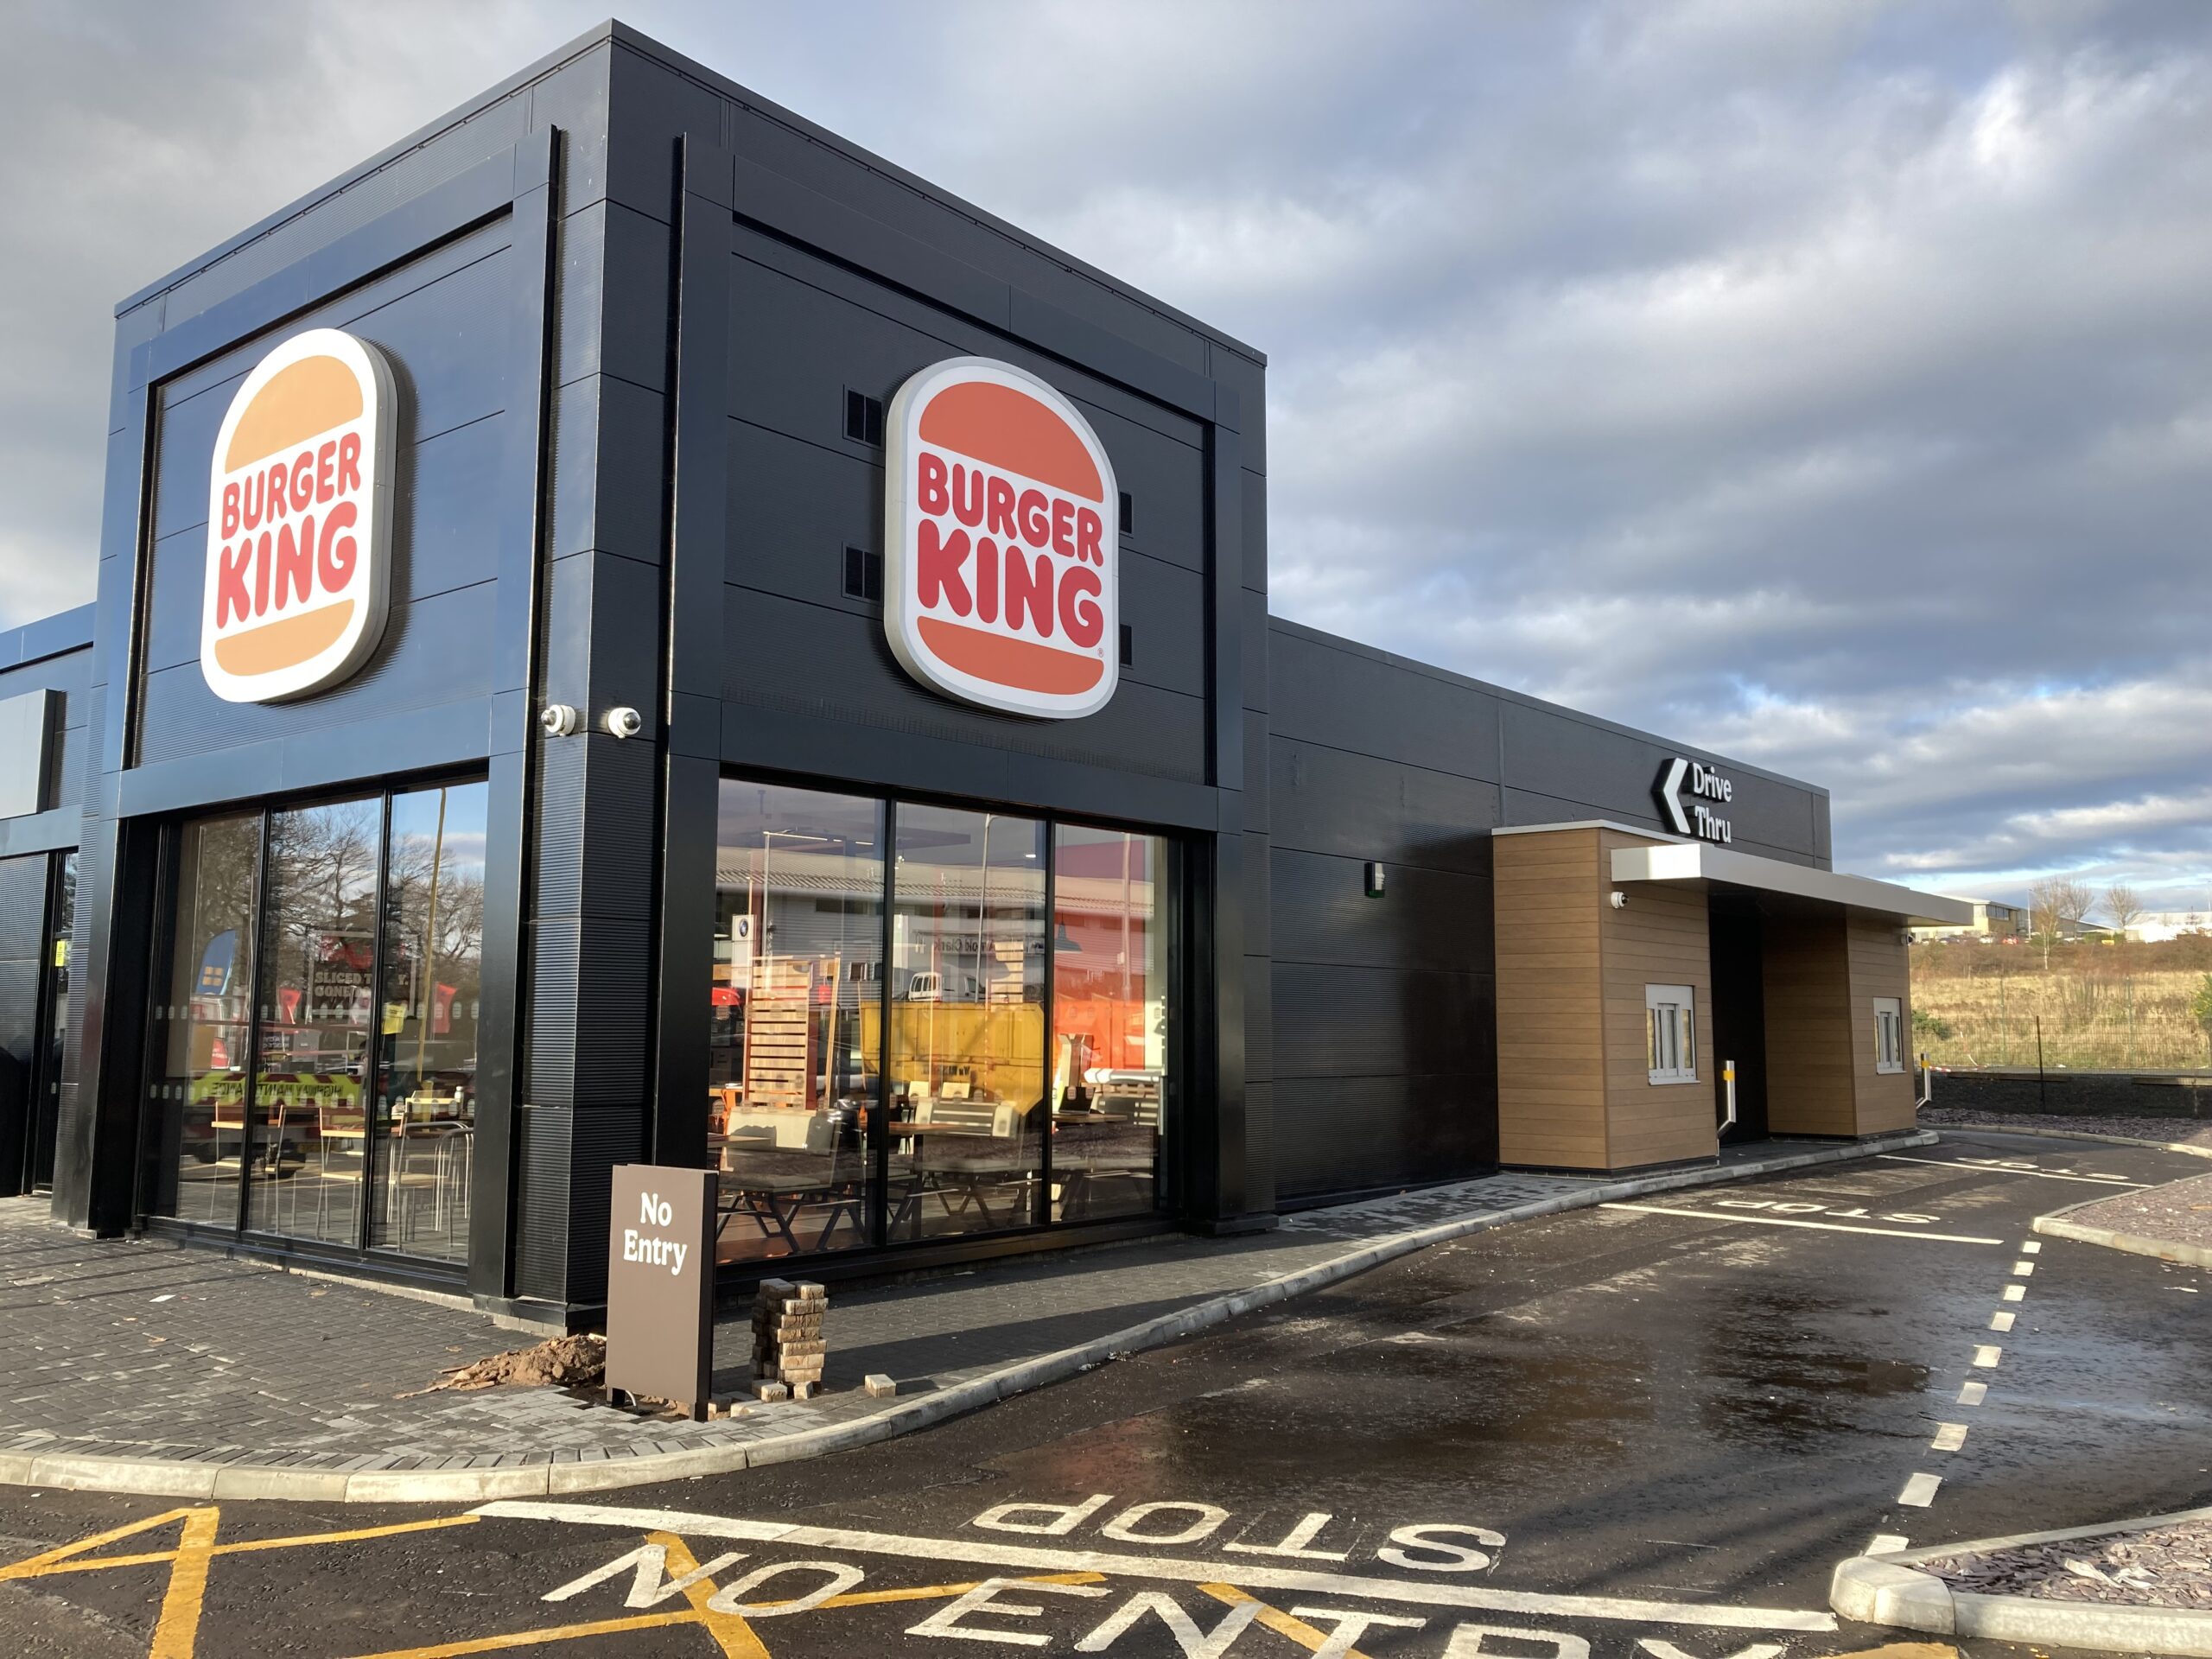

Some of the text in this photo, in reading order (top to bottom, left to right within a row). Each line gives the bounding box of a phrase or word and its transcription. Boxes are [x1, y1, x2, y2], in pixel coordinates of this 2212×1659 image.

[221, 432, 361, 541] BURGER
[918, 451, 1104, 568] BURGER
[216, 501, 358, 630] KING
[917, 518, 1104, 649] KING
[1693, 762, 1732, 802] Drive
[1695, 805, 1732, 843] Thru
[314, 971, 362, 985] SLICED
[640, 1192, 672, 1227] No
[1713, 1199, 1941, 1224] STOP
[623, 1229, 688, 1276] Entry
[972, 1494, 1506, 1573] STOP
[541, 1543, 866, 1618] NO
